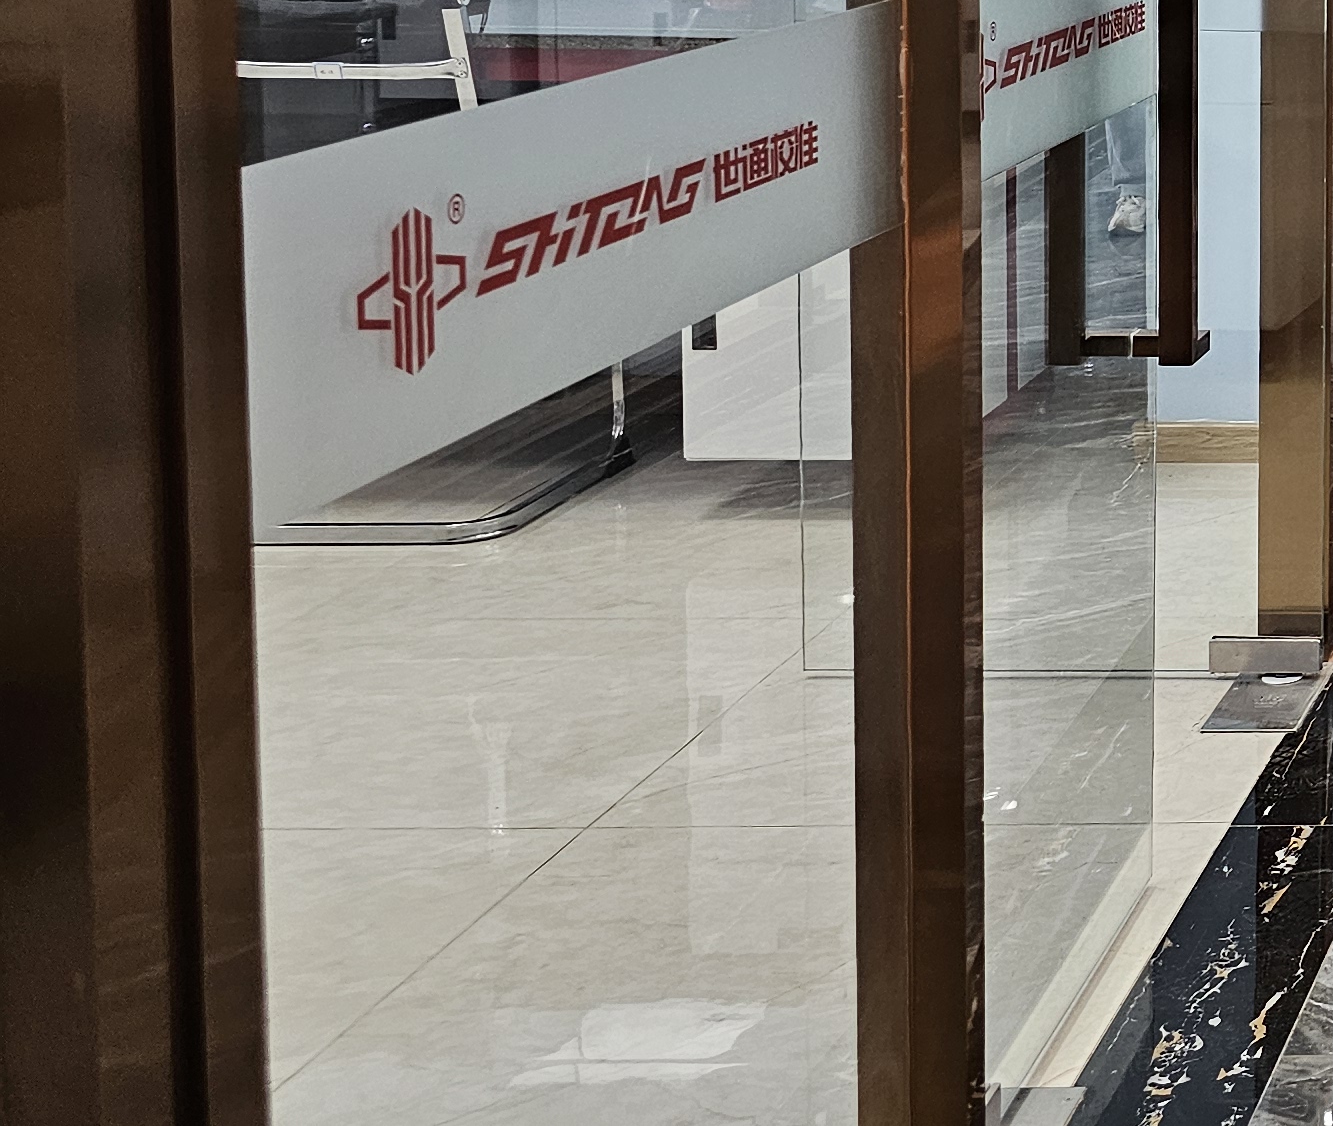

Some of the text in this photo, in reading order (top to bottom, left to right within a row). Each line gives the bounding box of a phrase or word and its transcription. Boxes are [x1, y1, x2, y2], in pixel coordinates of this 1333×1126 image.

[1099, 0, 1146, 49] 世通校准
[713, 120, 819, 203] 世通校准
